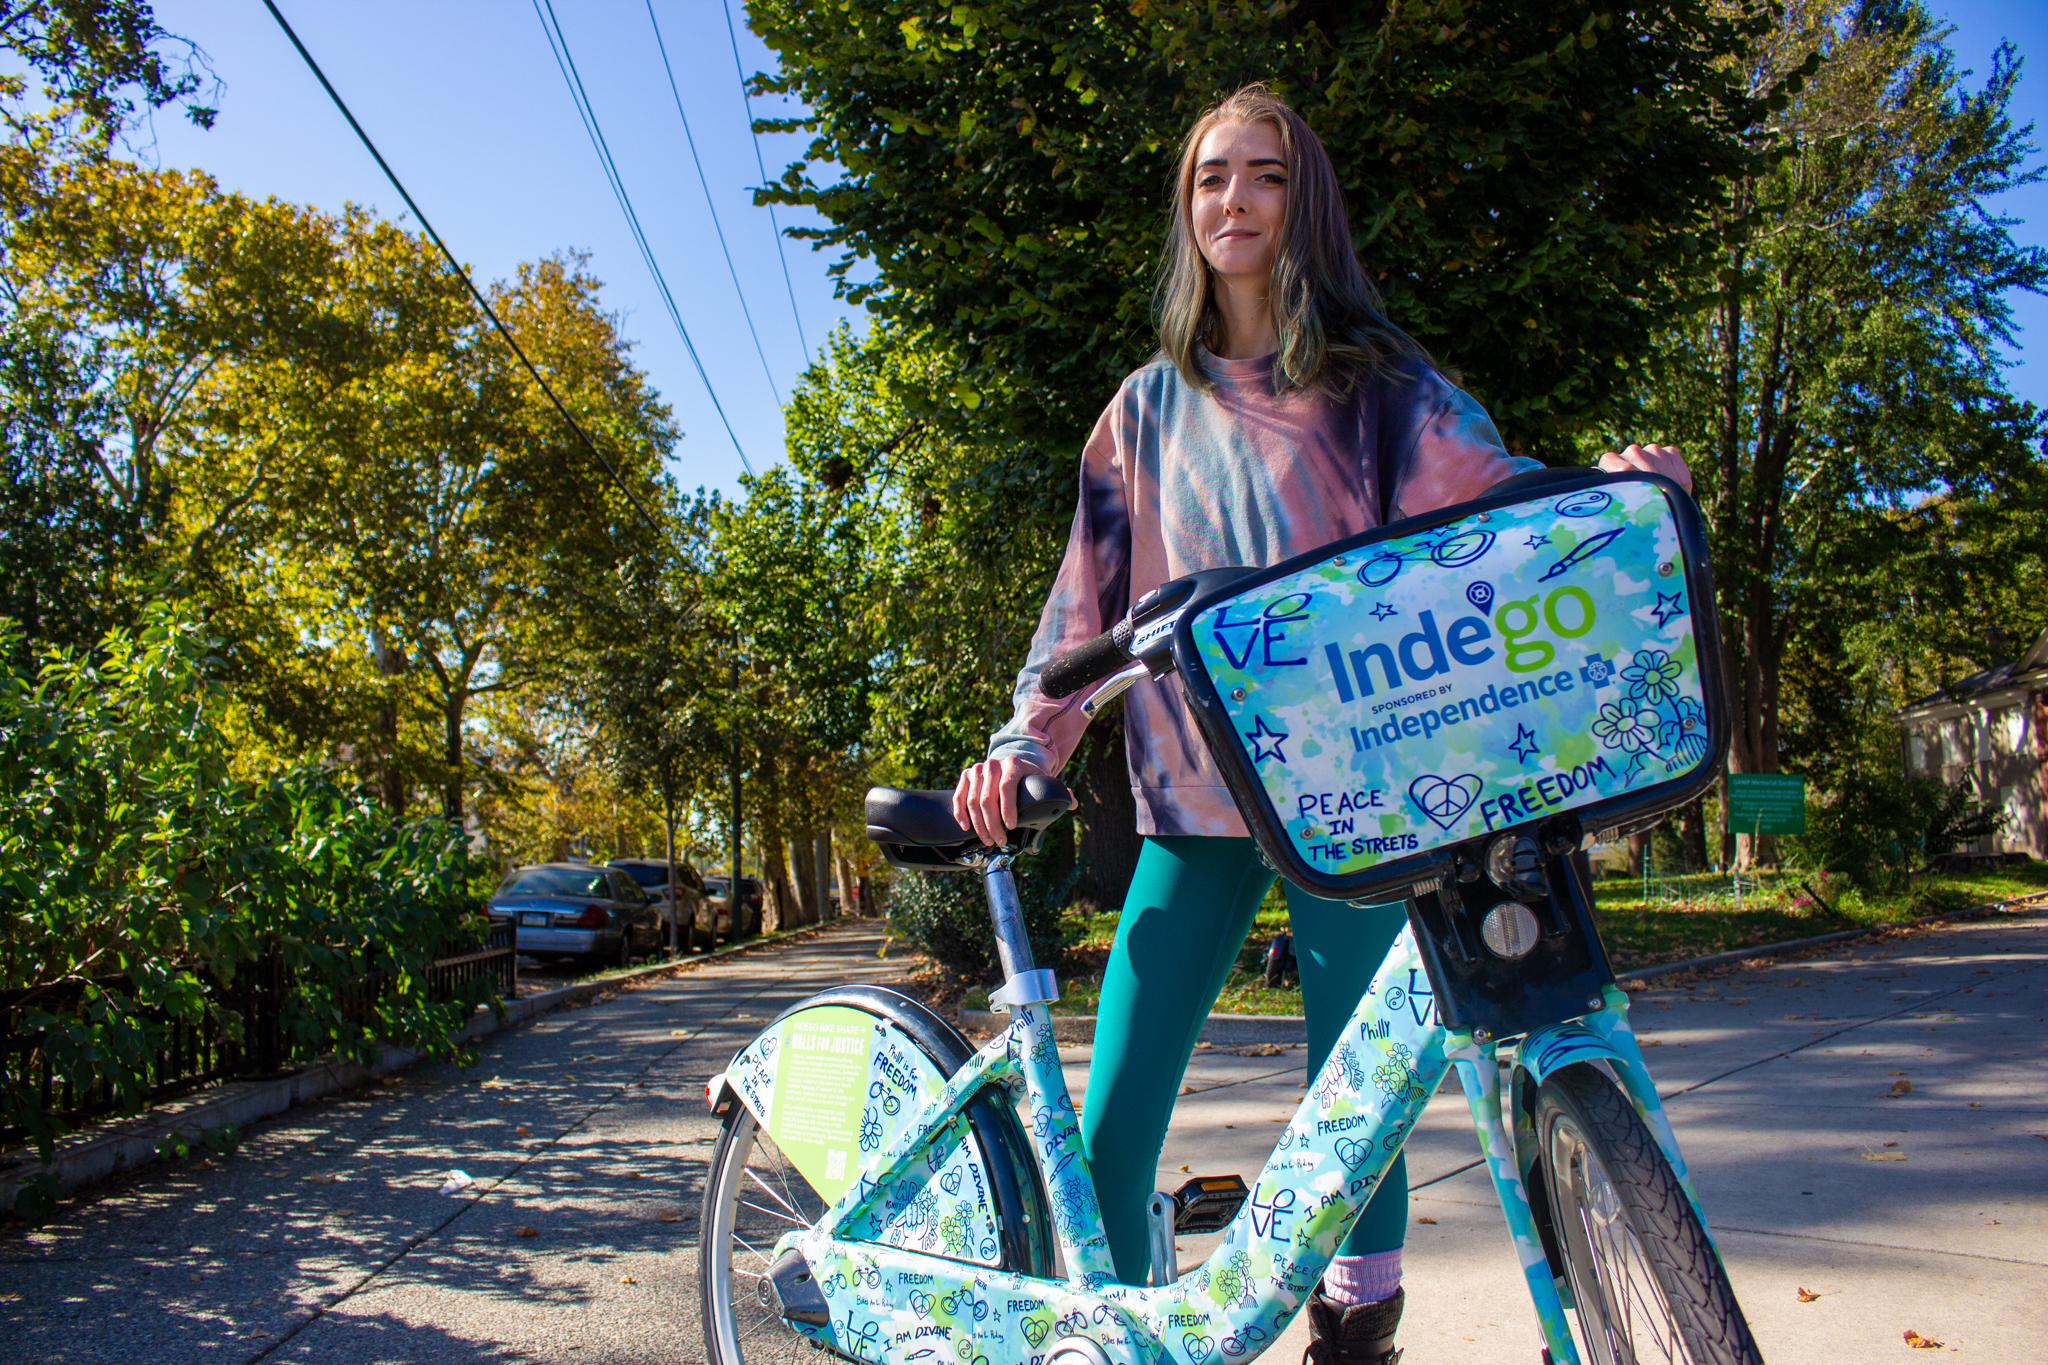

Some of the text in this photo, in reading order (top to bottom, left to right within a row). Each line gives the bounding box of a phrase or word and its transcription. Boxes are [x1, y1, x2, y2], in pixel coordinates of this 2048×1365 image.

[1137, 620, 1177, 645] SHIFT
[1324, 585, 1596, 704] Indego
[1371, 684, 1453, 714] SPONSORED BY
[1350, 670, 1575, 753] Independence
[1298, 789, 1384, 819] PEACE
[1479, 755, 1617, 832] FREEDOM
[1328, 817, 1354, 836] IN
[1307, 833, 1419, 862] THE STREETS
[794, 1022, 819, 1031] INDEGO
[820, 1023, 835, 1032] BIKE
[836, 1024, 859, 1034] SHARE
[817, 1037, 830, 1050] FOR
[831, 1037, 865, 1055] JUSTICE
[873, 1051, 918, 1101] FREEDOM
[1317, 1115, 1368, 1136] FREEDOM
[1320, 1190, 1345, 1209] AM
[1273, 1253, 1309, 1275] PEACE
[898, 1272, 934, 1285] FREEDOM
[1270, 1275, 1286, 1291] THE
[1280, 1271, 1293, 1281] IN
[1007, 1299, 1047, 1314] FREEDOM
[1168, 1313, 1212, 1329] FREEDOM
[883, 1338, 893, 1353] I
[896, 1330, 912, 1344] AM
[915, 1325, 953, 1341] DIVINE
